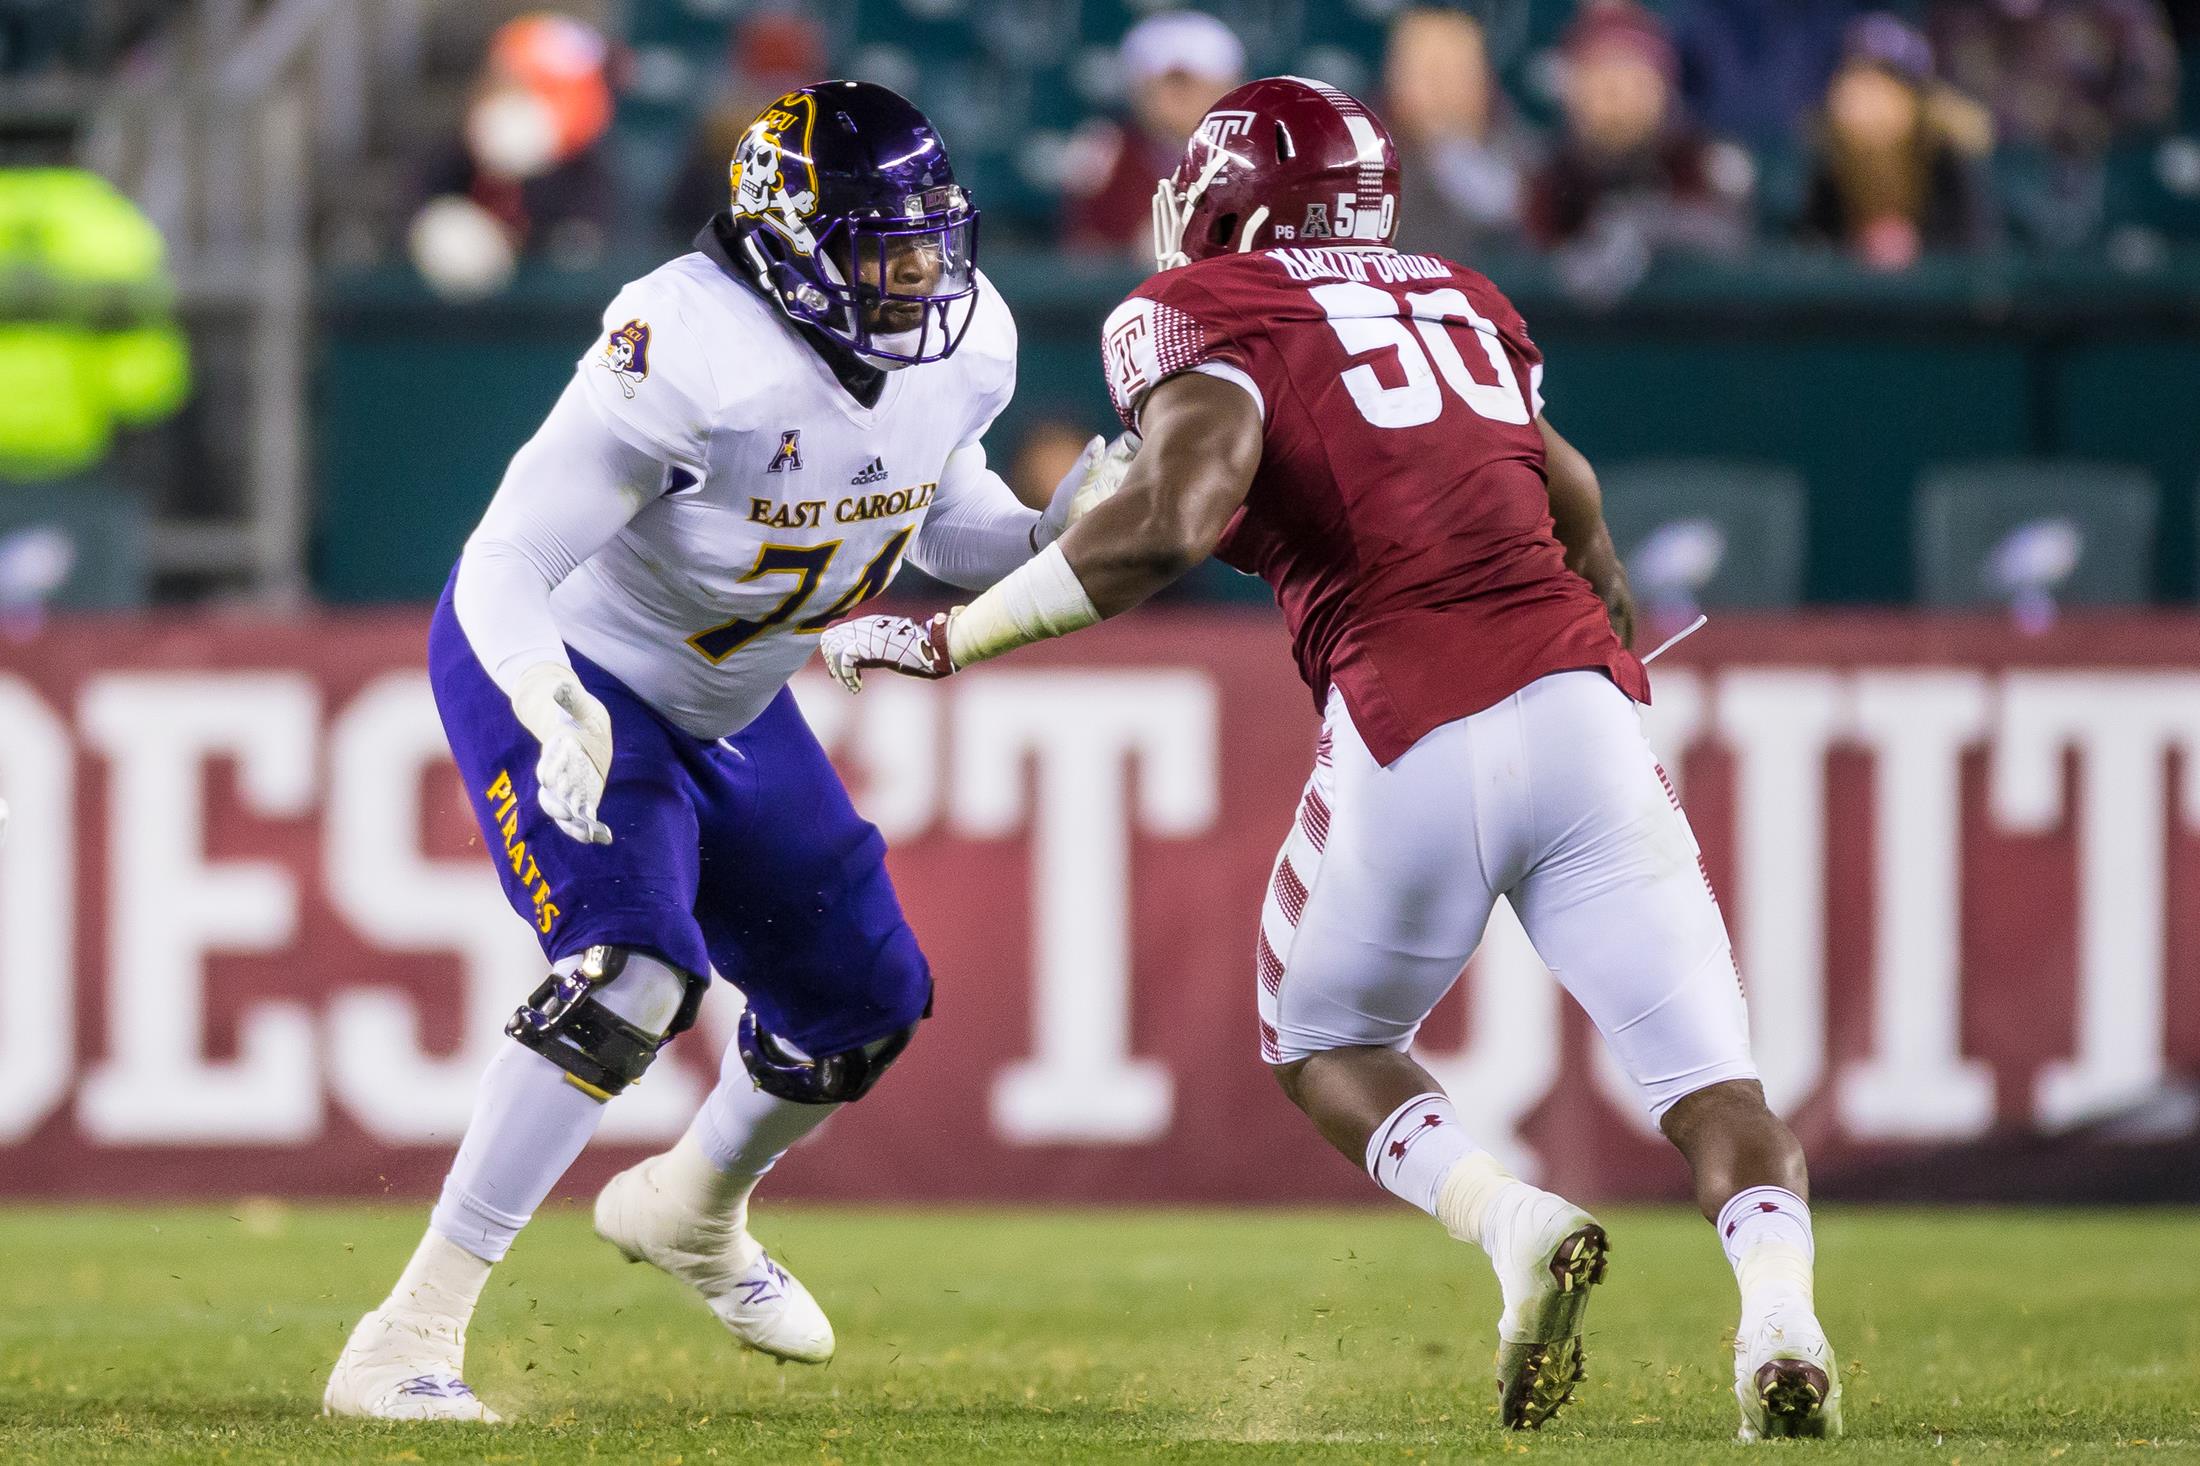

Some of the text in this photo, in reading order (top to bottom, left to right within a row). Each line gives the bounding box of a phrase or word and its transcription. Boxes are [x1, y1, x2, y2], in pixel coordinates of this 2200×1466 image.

[763, 109, 800, 131] ECU
[1274, 224, 1296, 240] P6
[623, 326, 646, 342] ECU
[1306, 280, 1531, 430] 50
[850, 471, 889, 486] adidas
[745, 495, 827, 530] EAST
[485, 768, 561, 935] PIRATES
